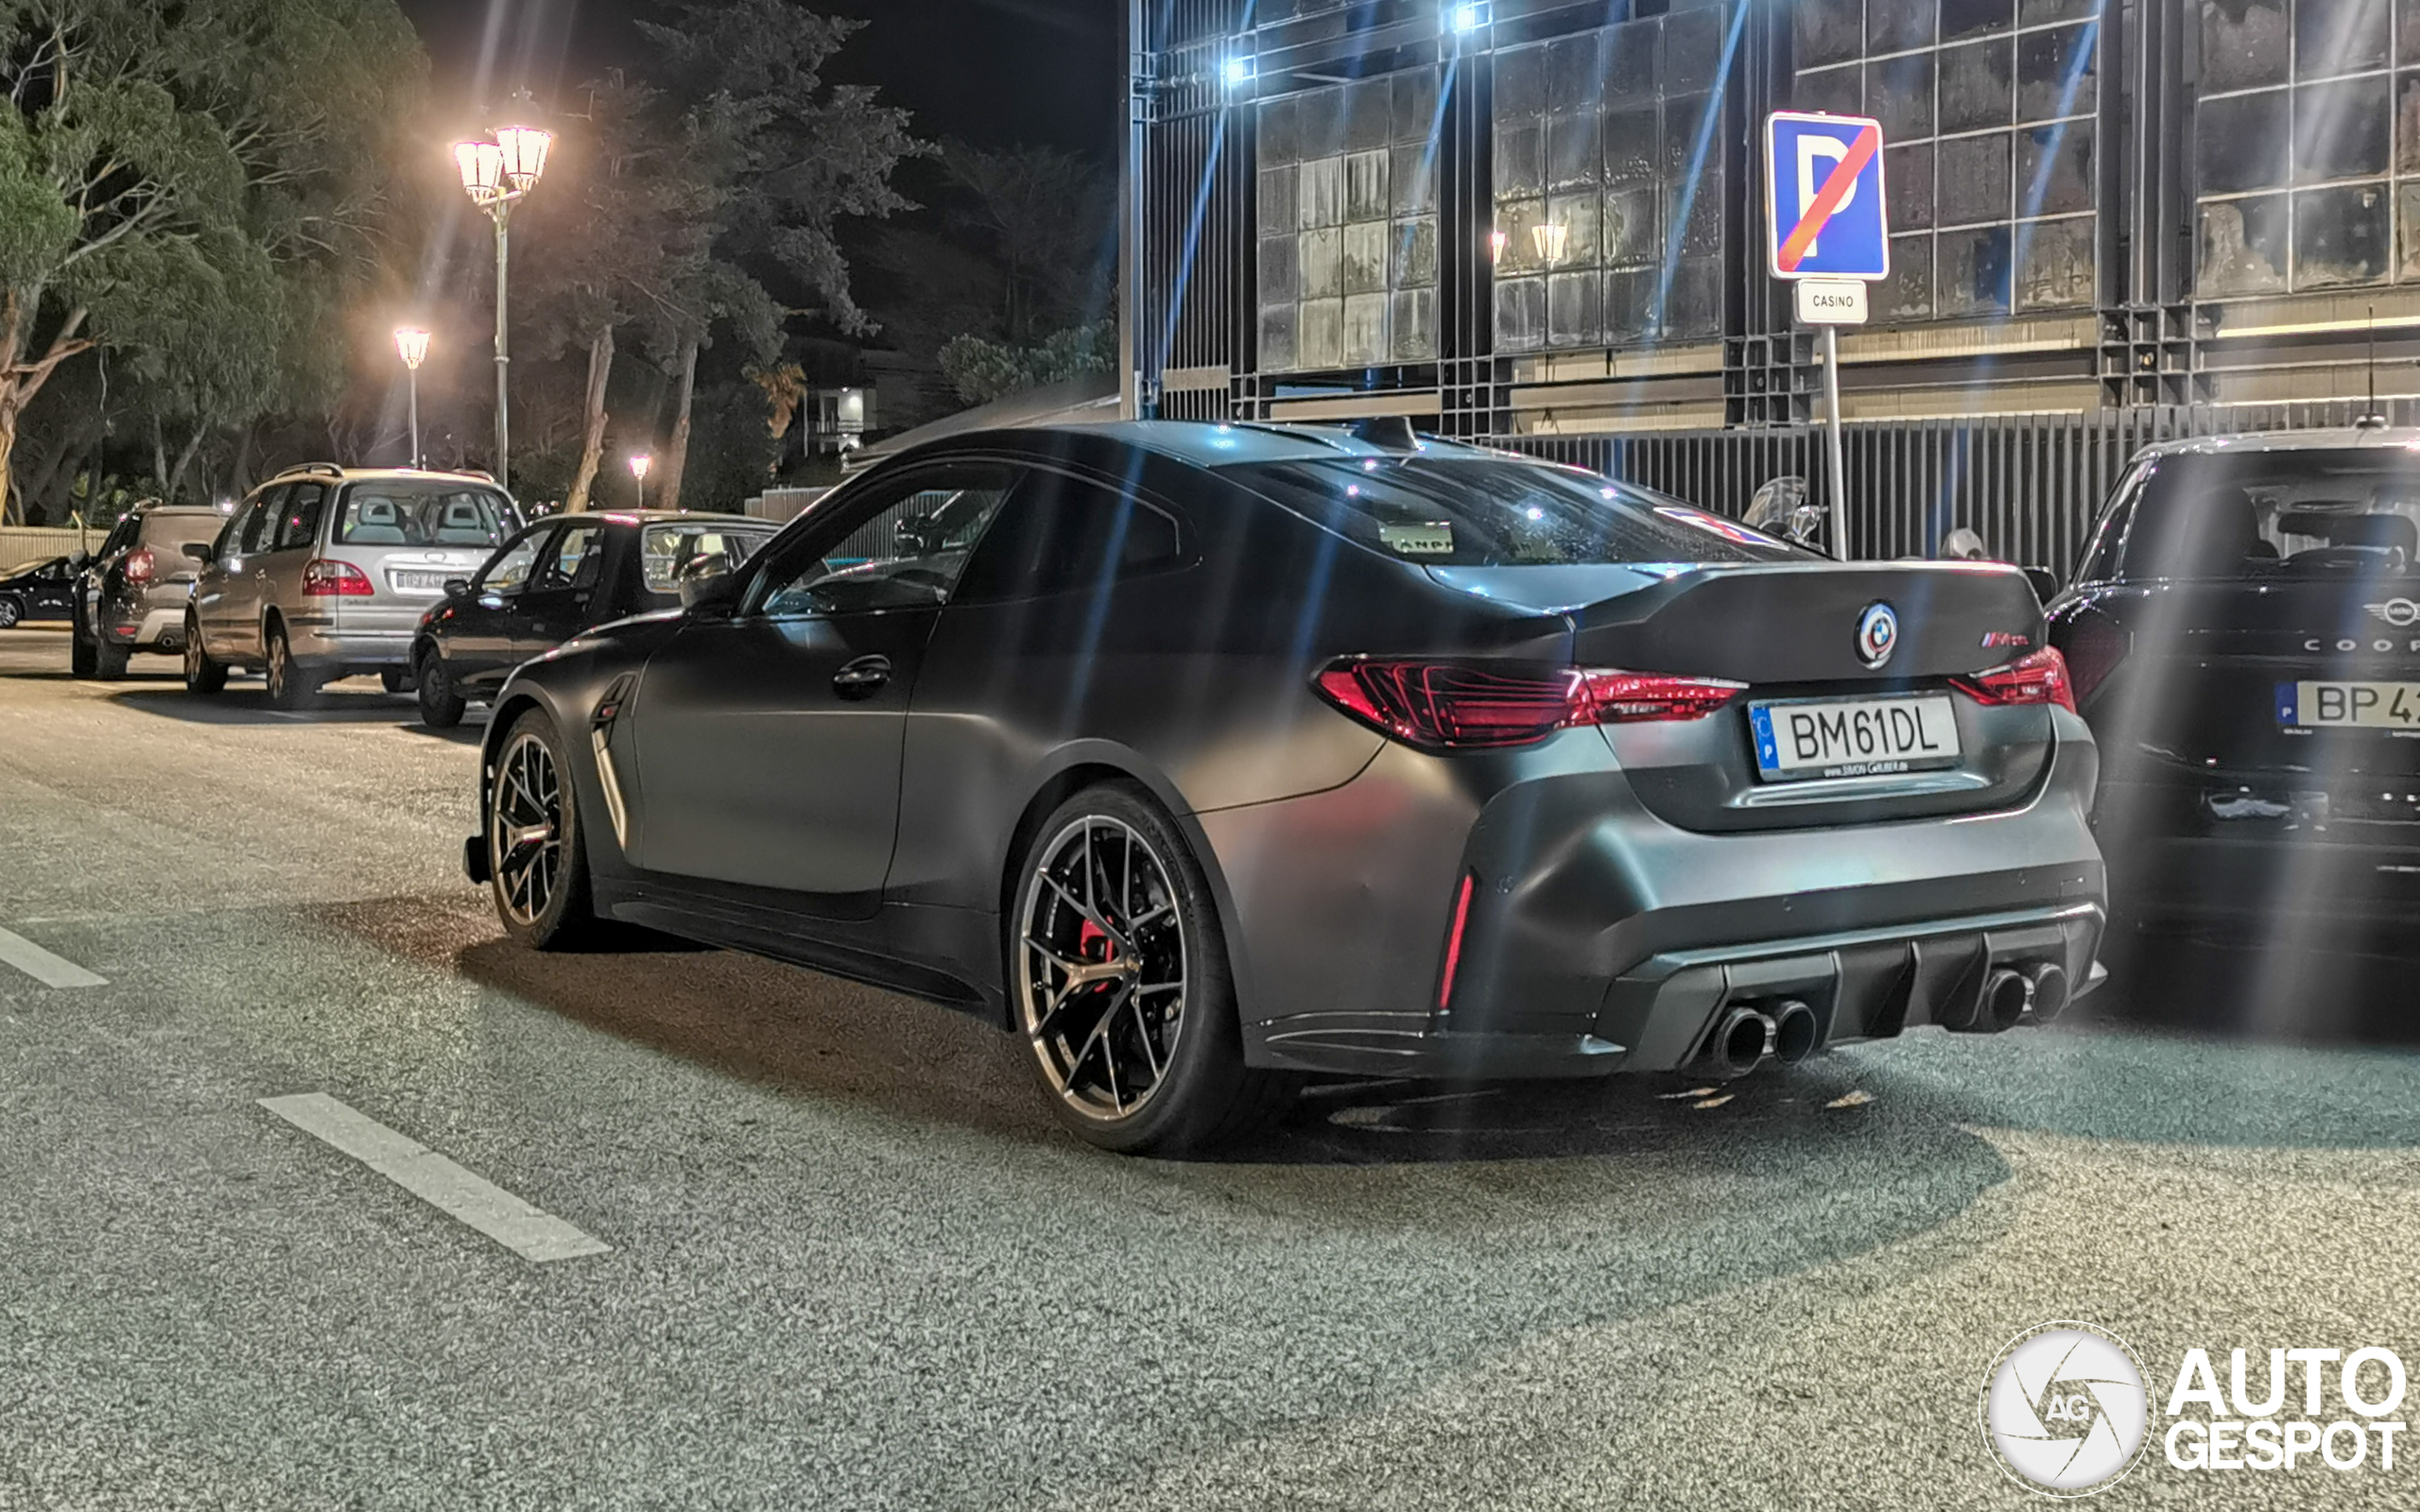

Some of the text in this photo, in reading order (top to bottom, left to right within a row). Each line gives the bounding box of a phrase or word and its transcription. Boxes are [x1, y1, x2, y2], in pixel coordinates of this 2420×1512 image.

[1796, 134, 1858, 258] P
[1812, 295, 1854, 308] CASINO
[1790, 706, 1939, 760] BM61DL
[1765, 744, 1773, 759] P
